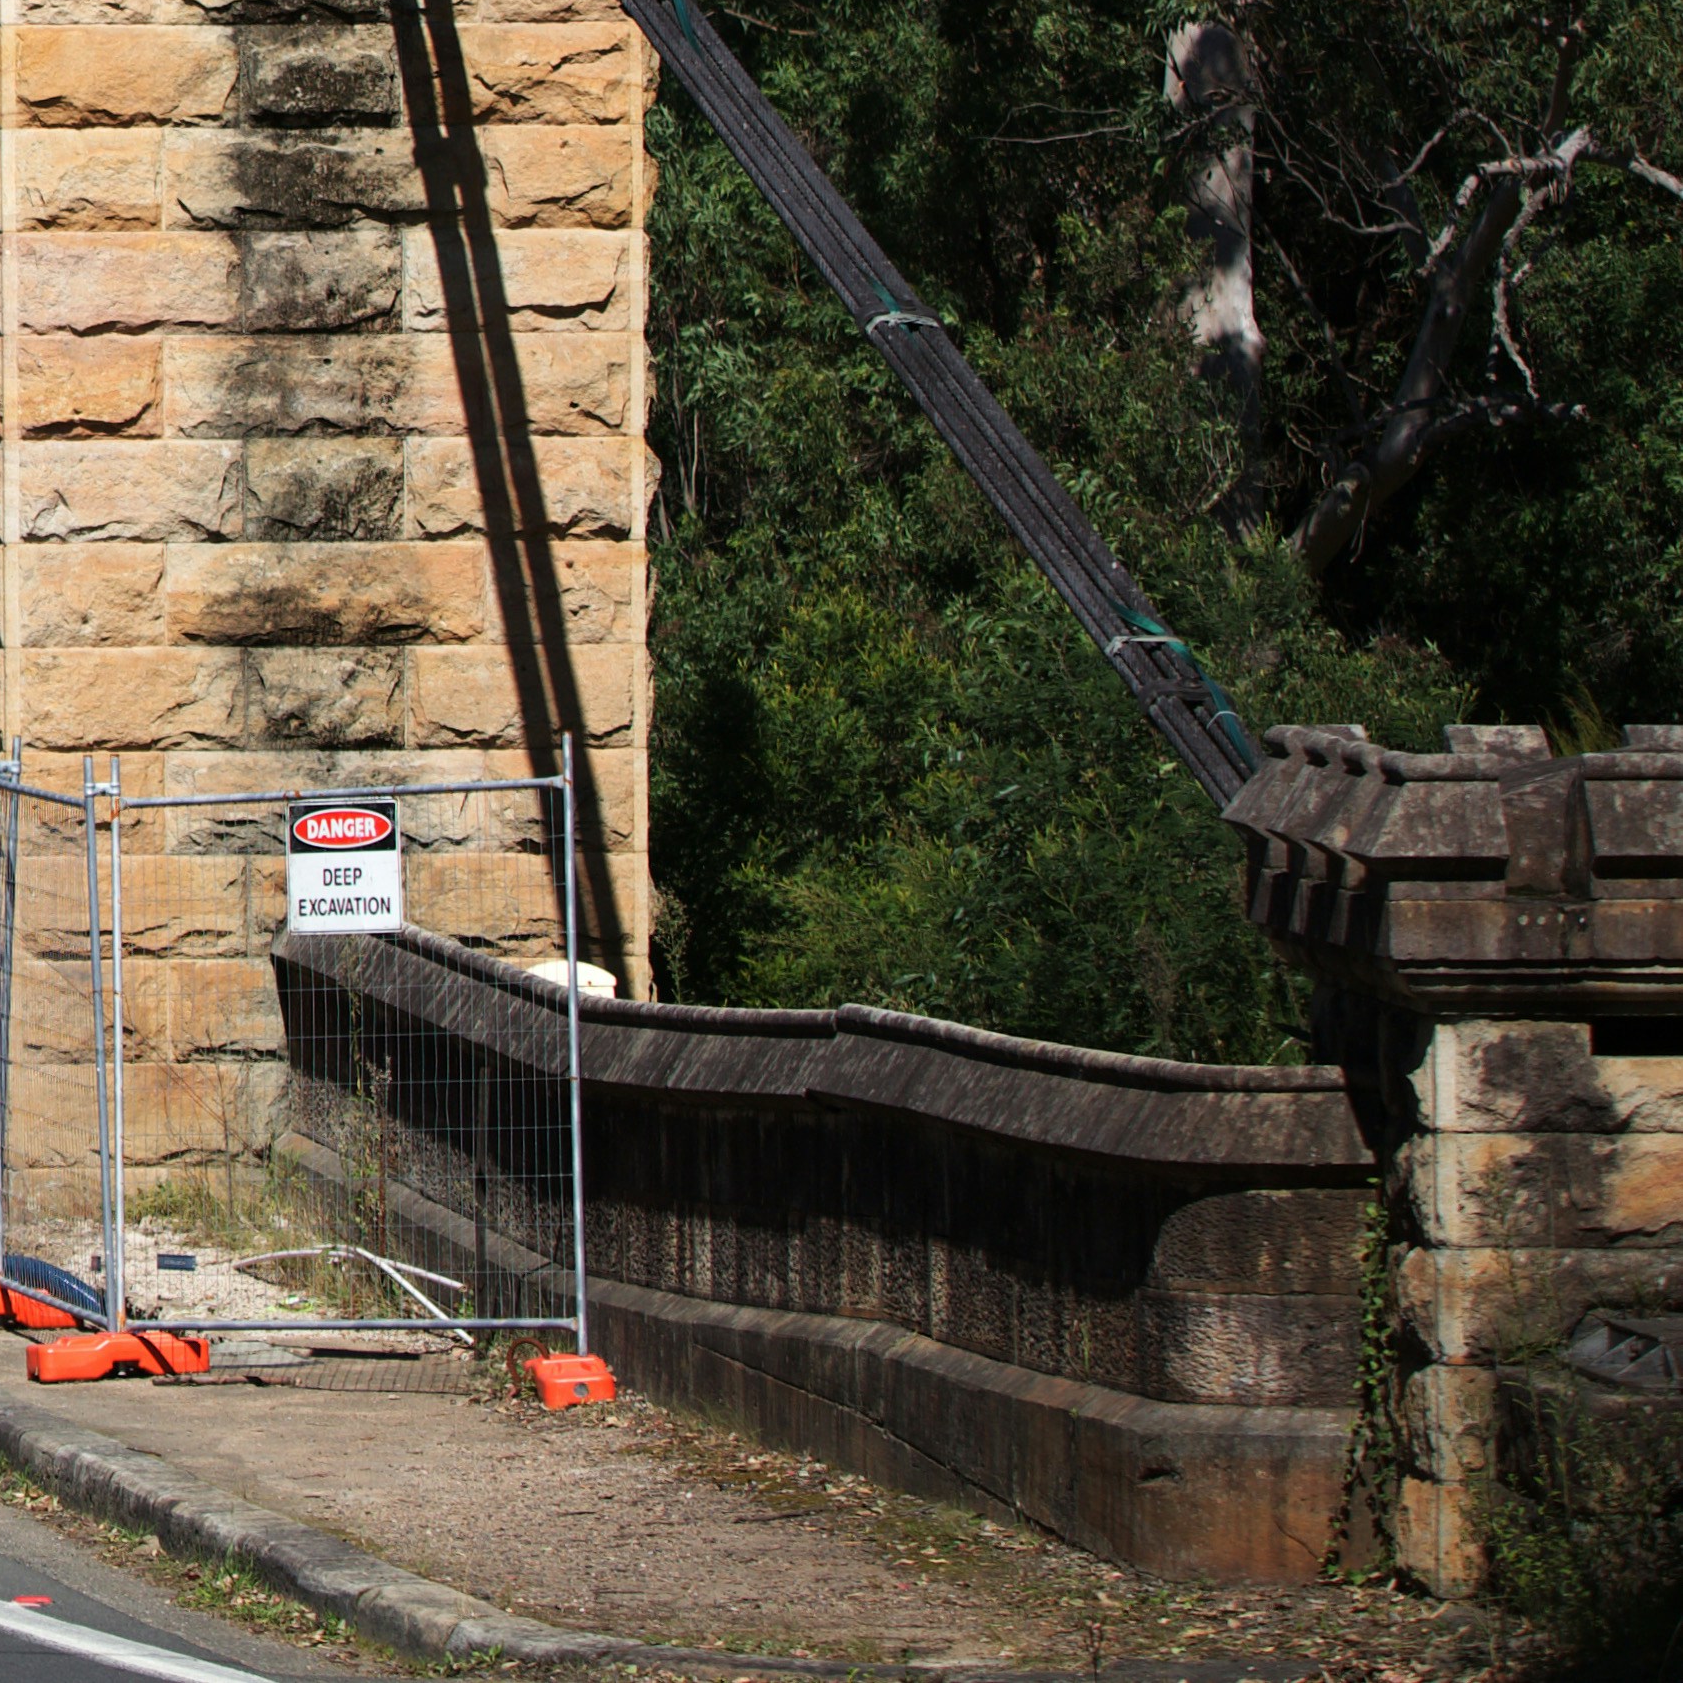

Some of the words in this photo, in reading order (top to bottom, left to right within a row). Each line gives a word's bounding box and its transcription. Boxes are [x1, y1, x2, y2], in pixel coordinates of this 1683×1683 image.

[306, 817, 377, 840] DANGER
[323, 867, 362, 887] DEEP
[298, 896, 391, 917] EXCAVATION
